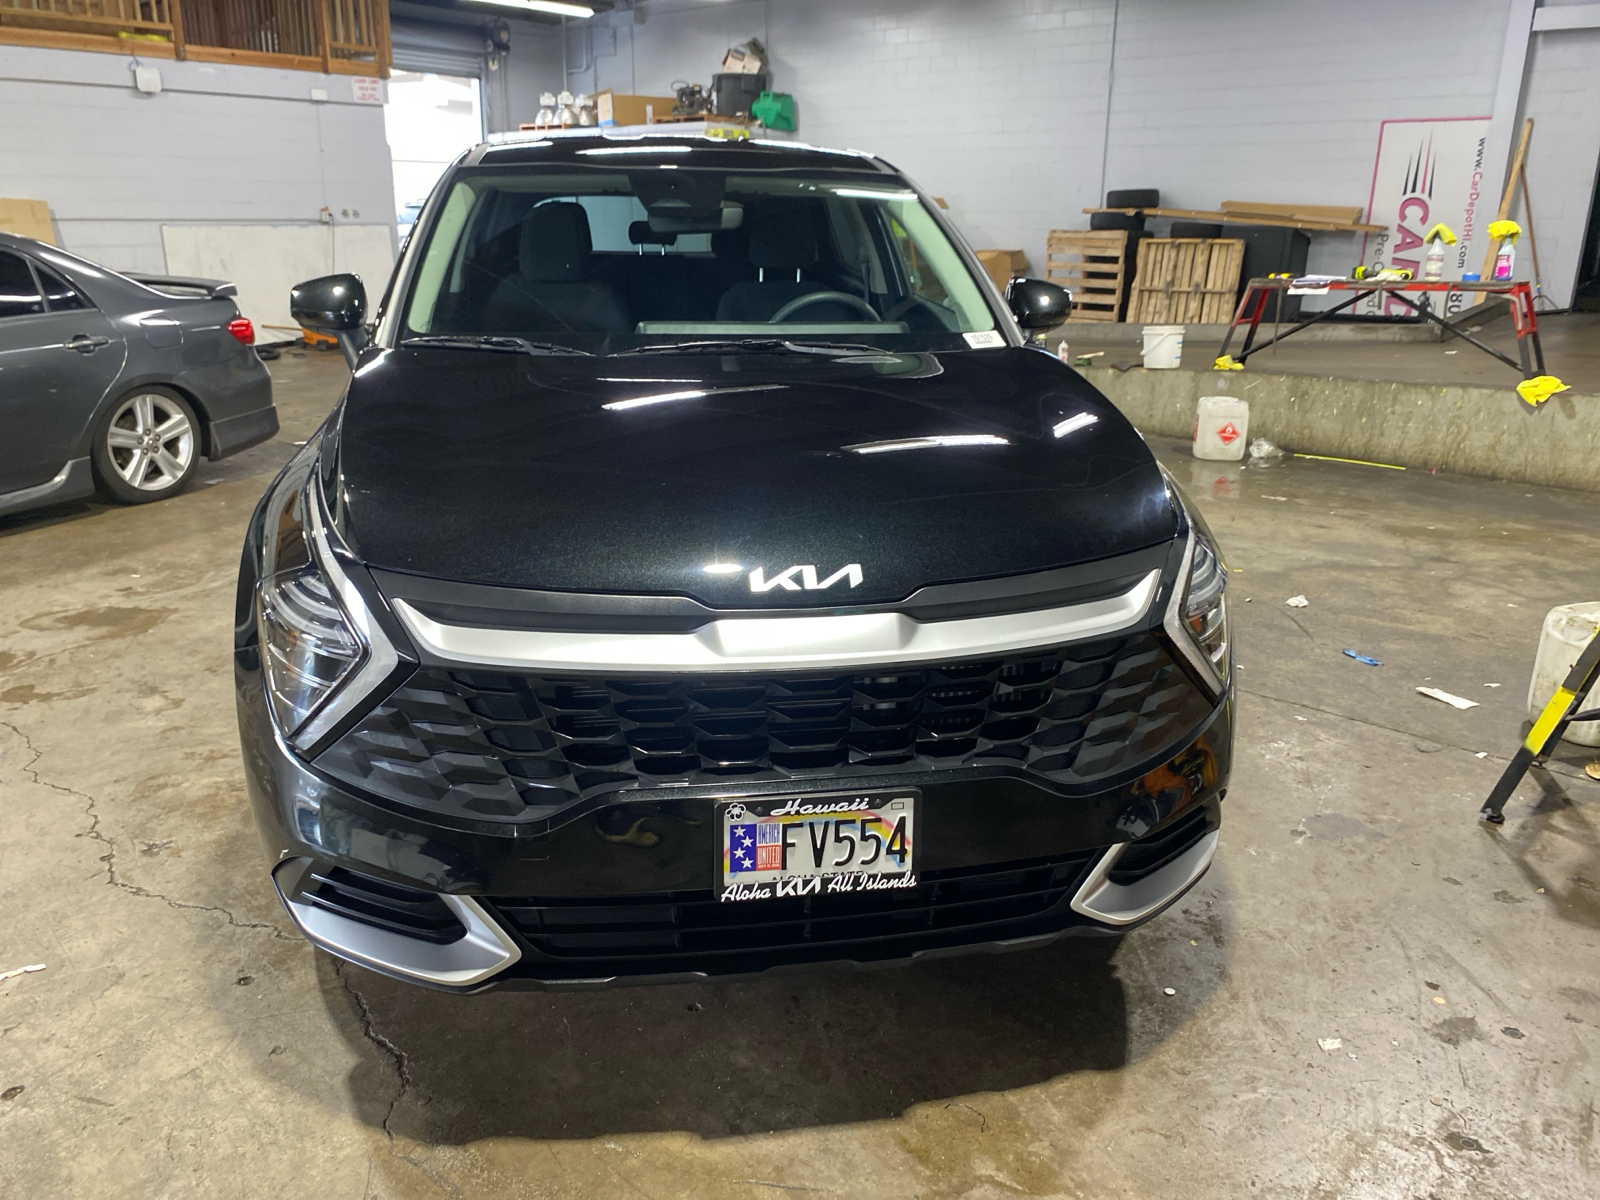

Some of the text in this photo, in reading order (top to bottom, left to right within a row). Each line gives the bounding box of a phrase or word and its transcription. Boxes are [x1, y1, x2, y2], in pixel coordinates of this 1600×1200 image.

[1457, 137, 1486, 269] www.CarDepotHI.com
[749, 563, 863, 593] KIA
[770, 798, 869, 816] Hawaii
[757, 846, 780, 864] UNITED
[781, 815, 908, 870] FV554
[721, 881, 771, 902] Aloha
[776, 876, 821, 897] KIA
[827, 873, 854, 893] All
[856, 870, 917, 891] Islands
